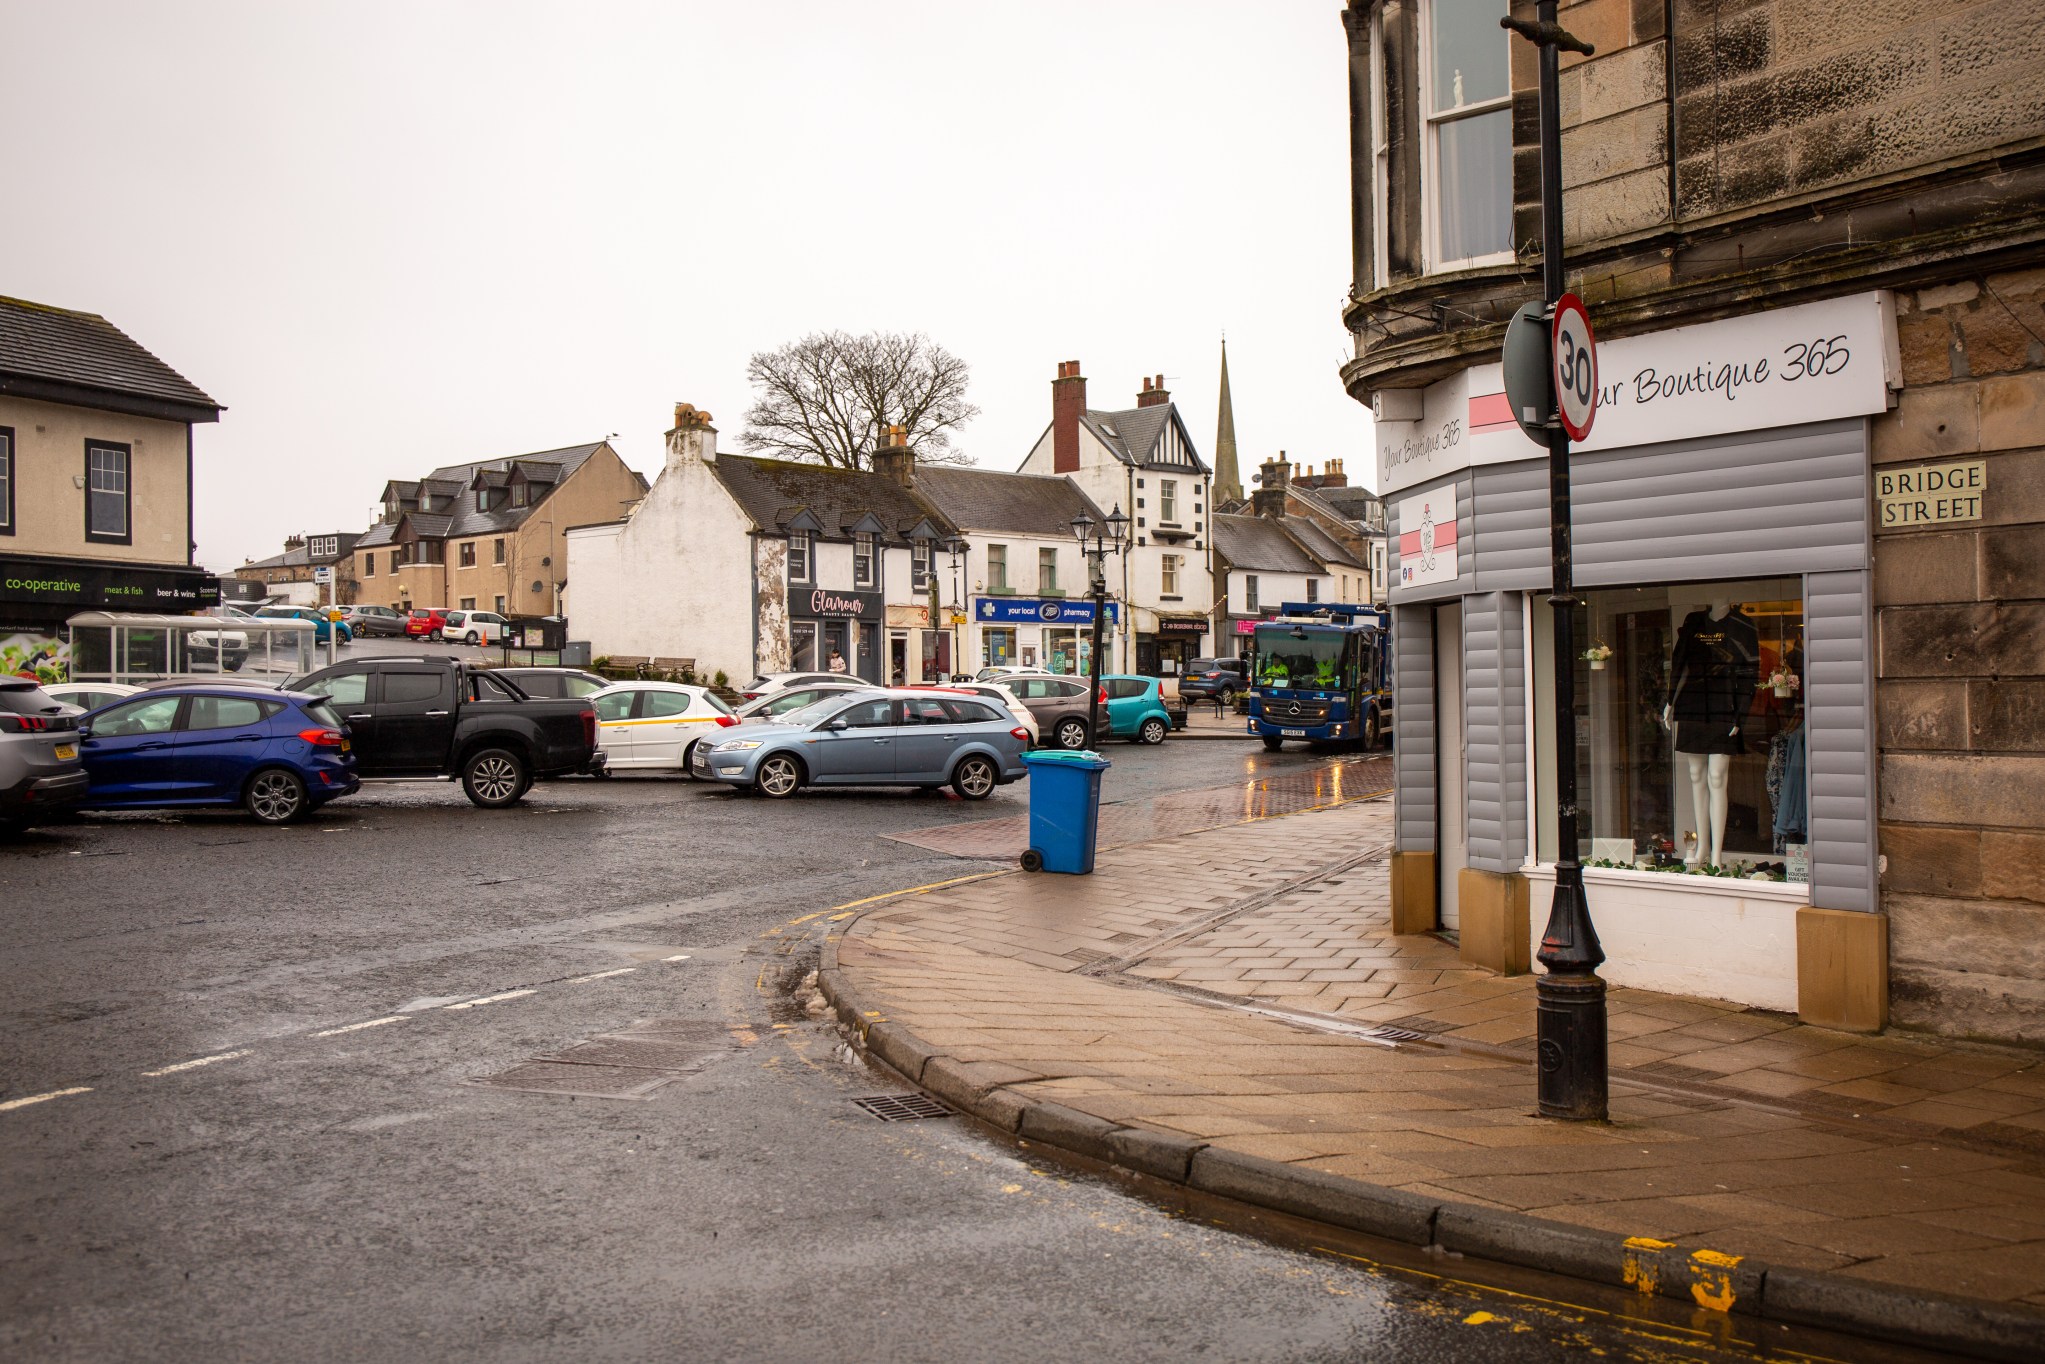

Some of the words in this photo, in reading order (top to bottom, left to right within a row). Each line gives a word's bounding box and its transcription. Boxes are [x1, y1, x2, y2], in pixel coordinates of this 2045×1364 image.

[1560, 329, 1591, 406] 30
[1596, 382, 1623, 408] ur
[1633, 358, 1770, 404] Boutique
[1780, 335, 1850, 381] 365
[1374, 394, 1380, 418] 6
[1384, 444, 1402, 482] Your
[1403, 433, 1440, 463] Boutique
[1442, 418, 1461, 450] 365
[1881, 467, 1981, 496] BRIDGE
[1885, 497, 1980, 523] STREET
[6, 579, 81, 594] co-operative
[124, 586, 129, 595] &
[131, 586, 143, 596] fish
[157, 588, 172, 597] beer
[174, 589, 179, 597] &
[181, 590, 196, 598] wine
[811, 590, 865, 613] Glamour
[1008, 607, 1021, 615] your
[1021, 607, 1036, 615] local
[1064, 609, 1091, 618] pharmacy
